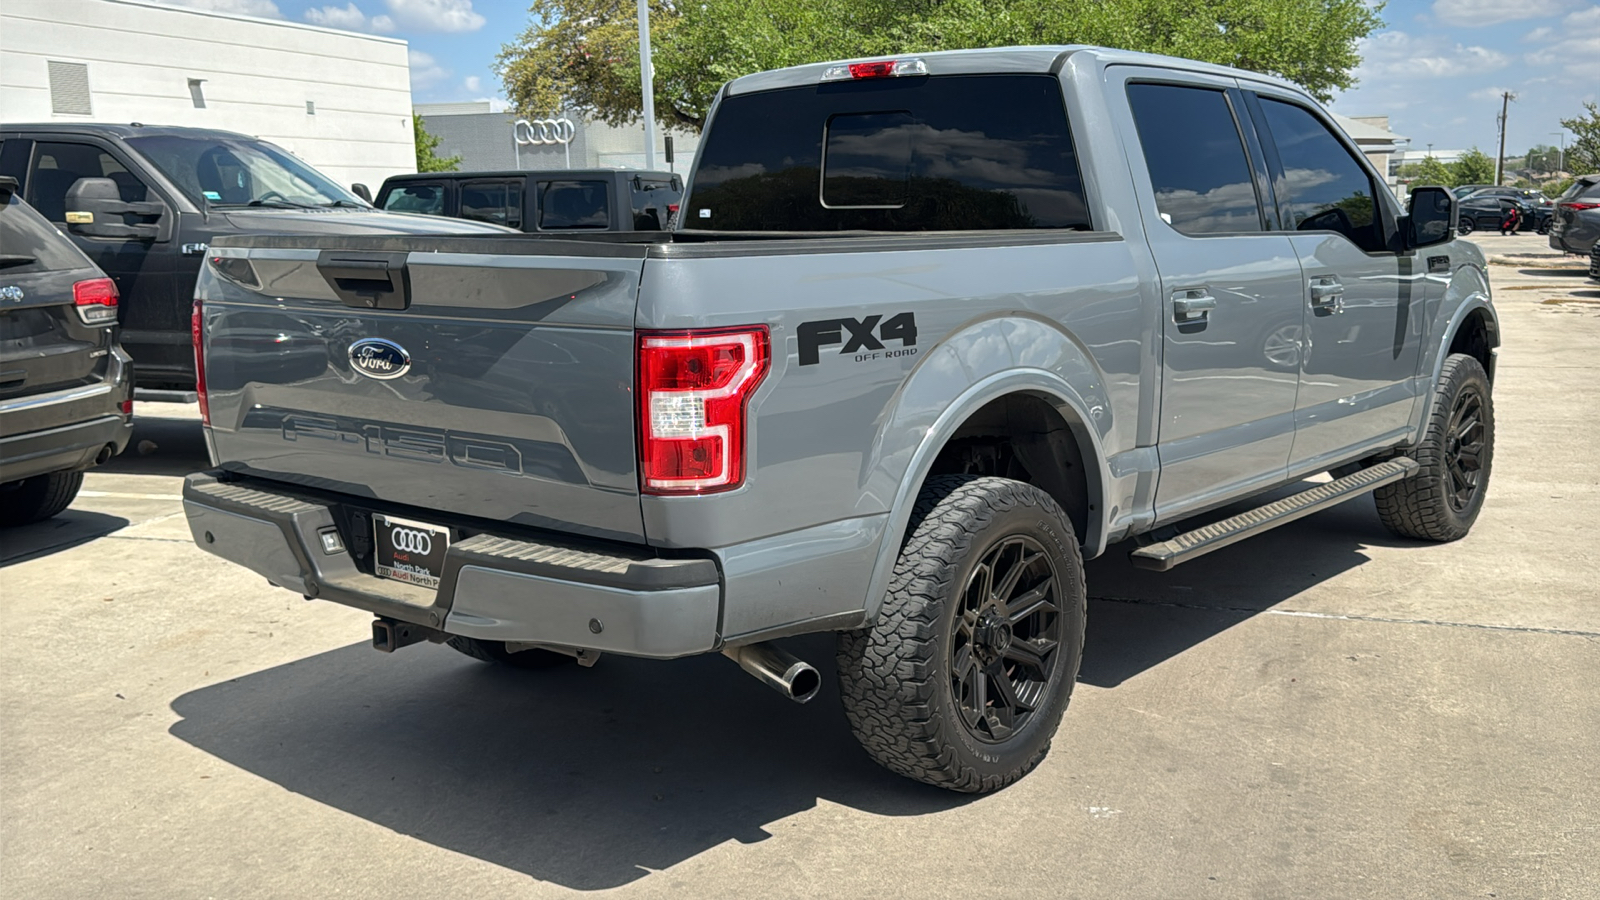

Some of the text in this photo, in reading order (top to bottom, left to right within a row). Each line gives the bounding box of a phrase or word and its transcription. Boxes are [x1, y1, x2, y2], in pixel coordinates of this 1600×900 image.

[0, 285, 24, 302] eep
[796, 311, 918, 367] FX4
[357, 345, 394, 371] Ford
[854, 347, 918, 363] OFF ROAD
[393, 552, 409, 560] Audi
[394, 561, 430, 575] North Park
[392, 571, 408, 580] Audi
[410, 574, 432, 585] North
